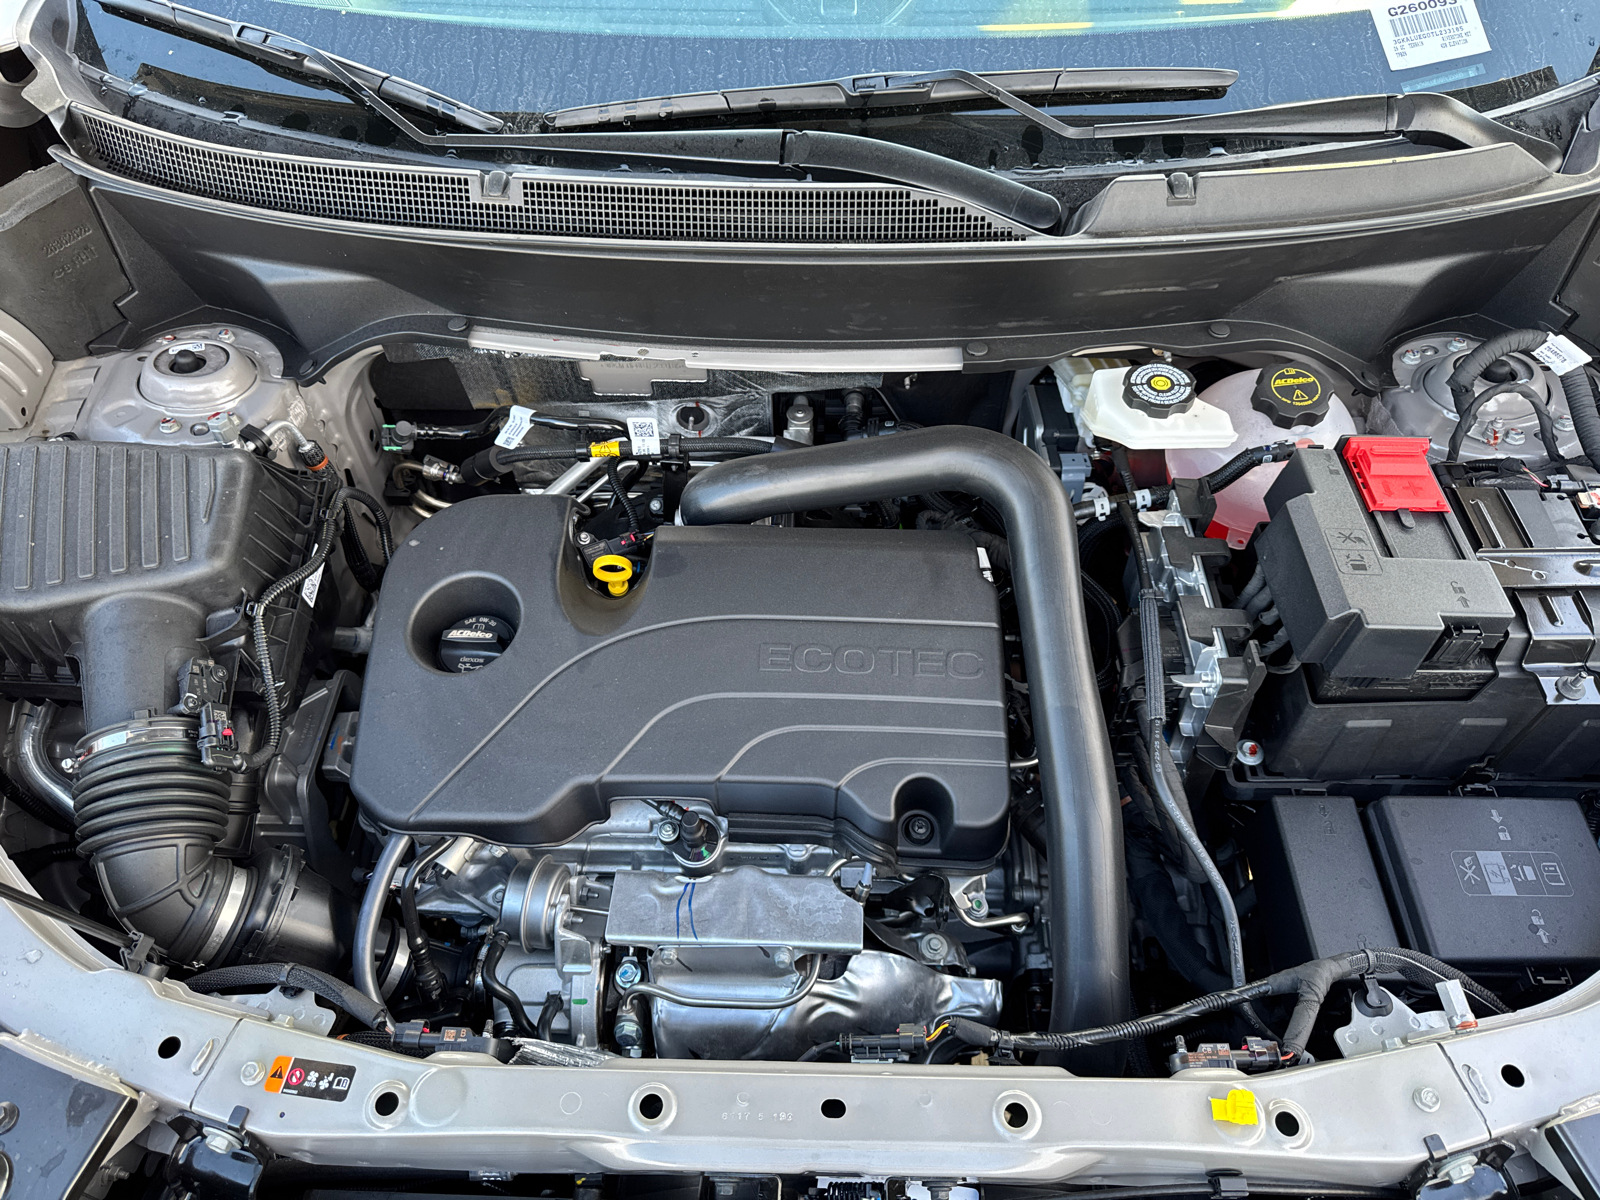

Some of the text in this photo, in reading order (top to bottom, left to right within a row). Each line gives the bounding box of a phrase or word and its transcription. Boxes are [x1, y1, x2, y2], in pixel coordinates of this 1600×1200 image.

[1274, 377, 1315, 386] ACDelco
[464, 617, 477, 625] SAE
[447, 630, 493, 639] ACDelco
[759, 642, 984, 680] ECOTEC
[303, 1080, 317, 1088] AUTO
